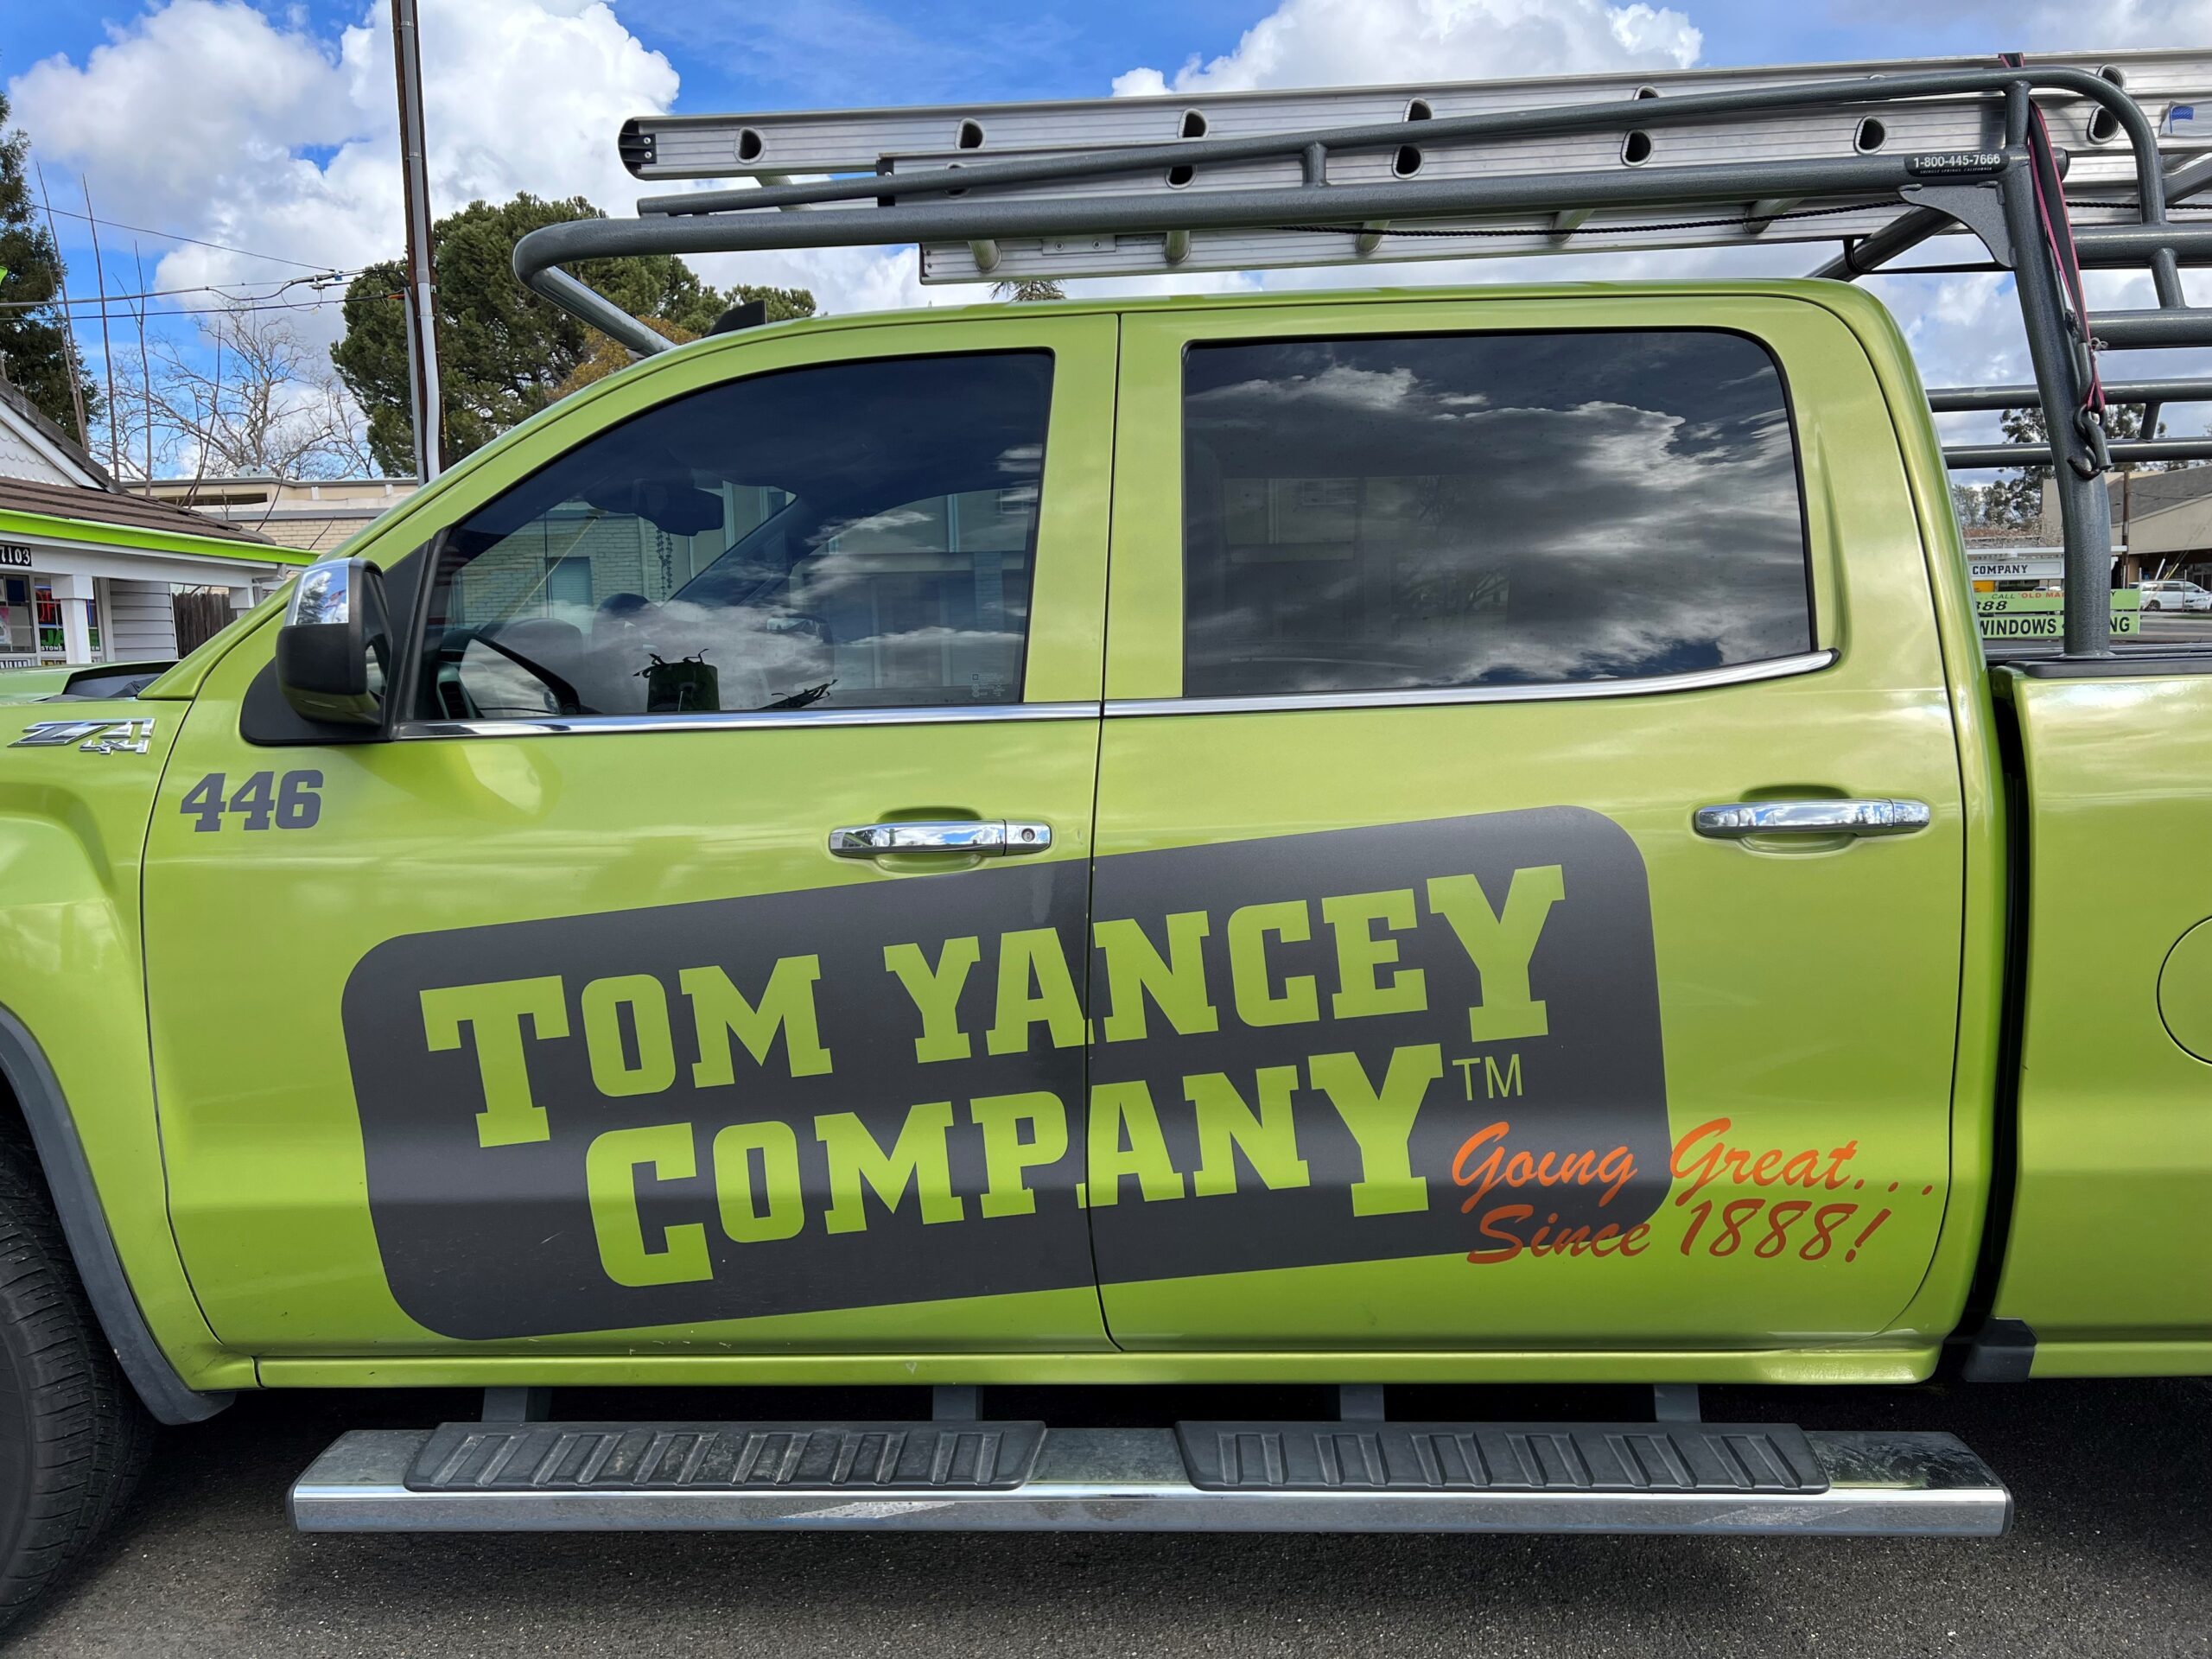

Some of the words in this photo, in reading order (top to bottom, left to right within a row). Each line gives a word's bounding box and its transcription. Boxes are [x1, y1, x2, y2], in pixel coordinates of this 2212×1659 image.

[1914, 154, 2000, 168] 1-800-445-7666
[1972, 564, 2028, 575] COMPANY
[1980, 618, 2056, 635] WINDOWS
[180, 769, 324, 832] 446
[420, 954, 833, 1147] TOM
[883, 865, 1565, 1064] YANCEY
[586, 1043, 1444, 1287] COMPANY
[1452, 1053, 1522, 1101] TM
[1452, 1122, 1637, 1213] Going
[1467, 1205, 1650, 1264] Since
[1680, 1198, 1892, 1263] 1888!
